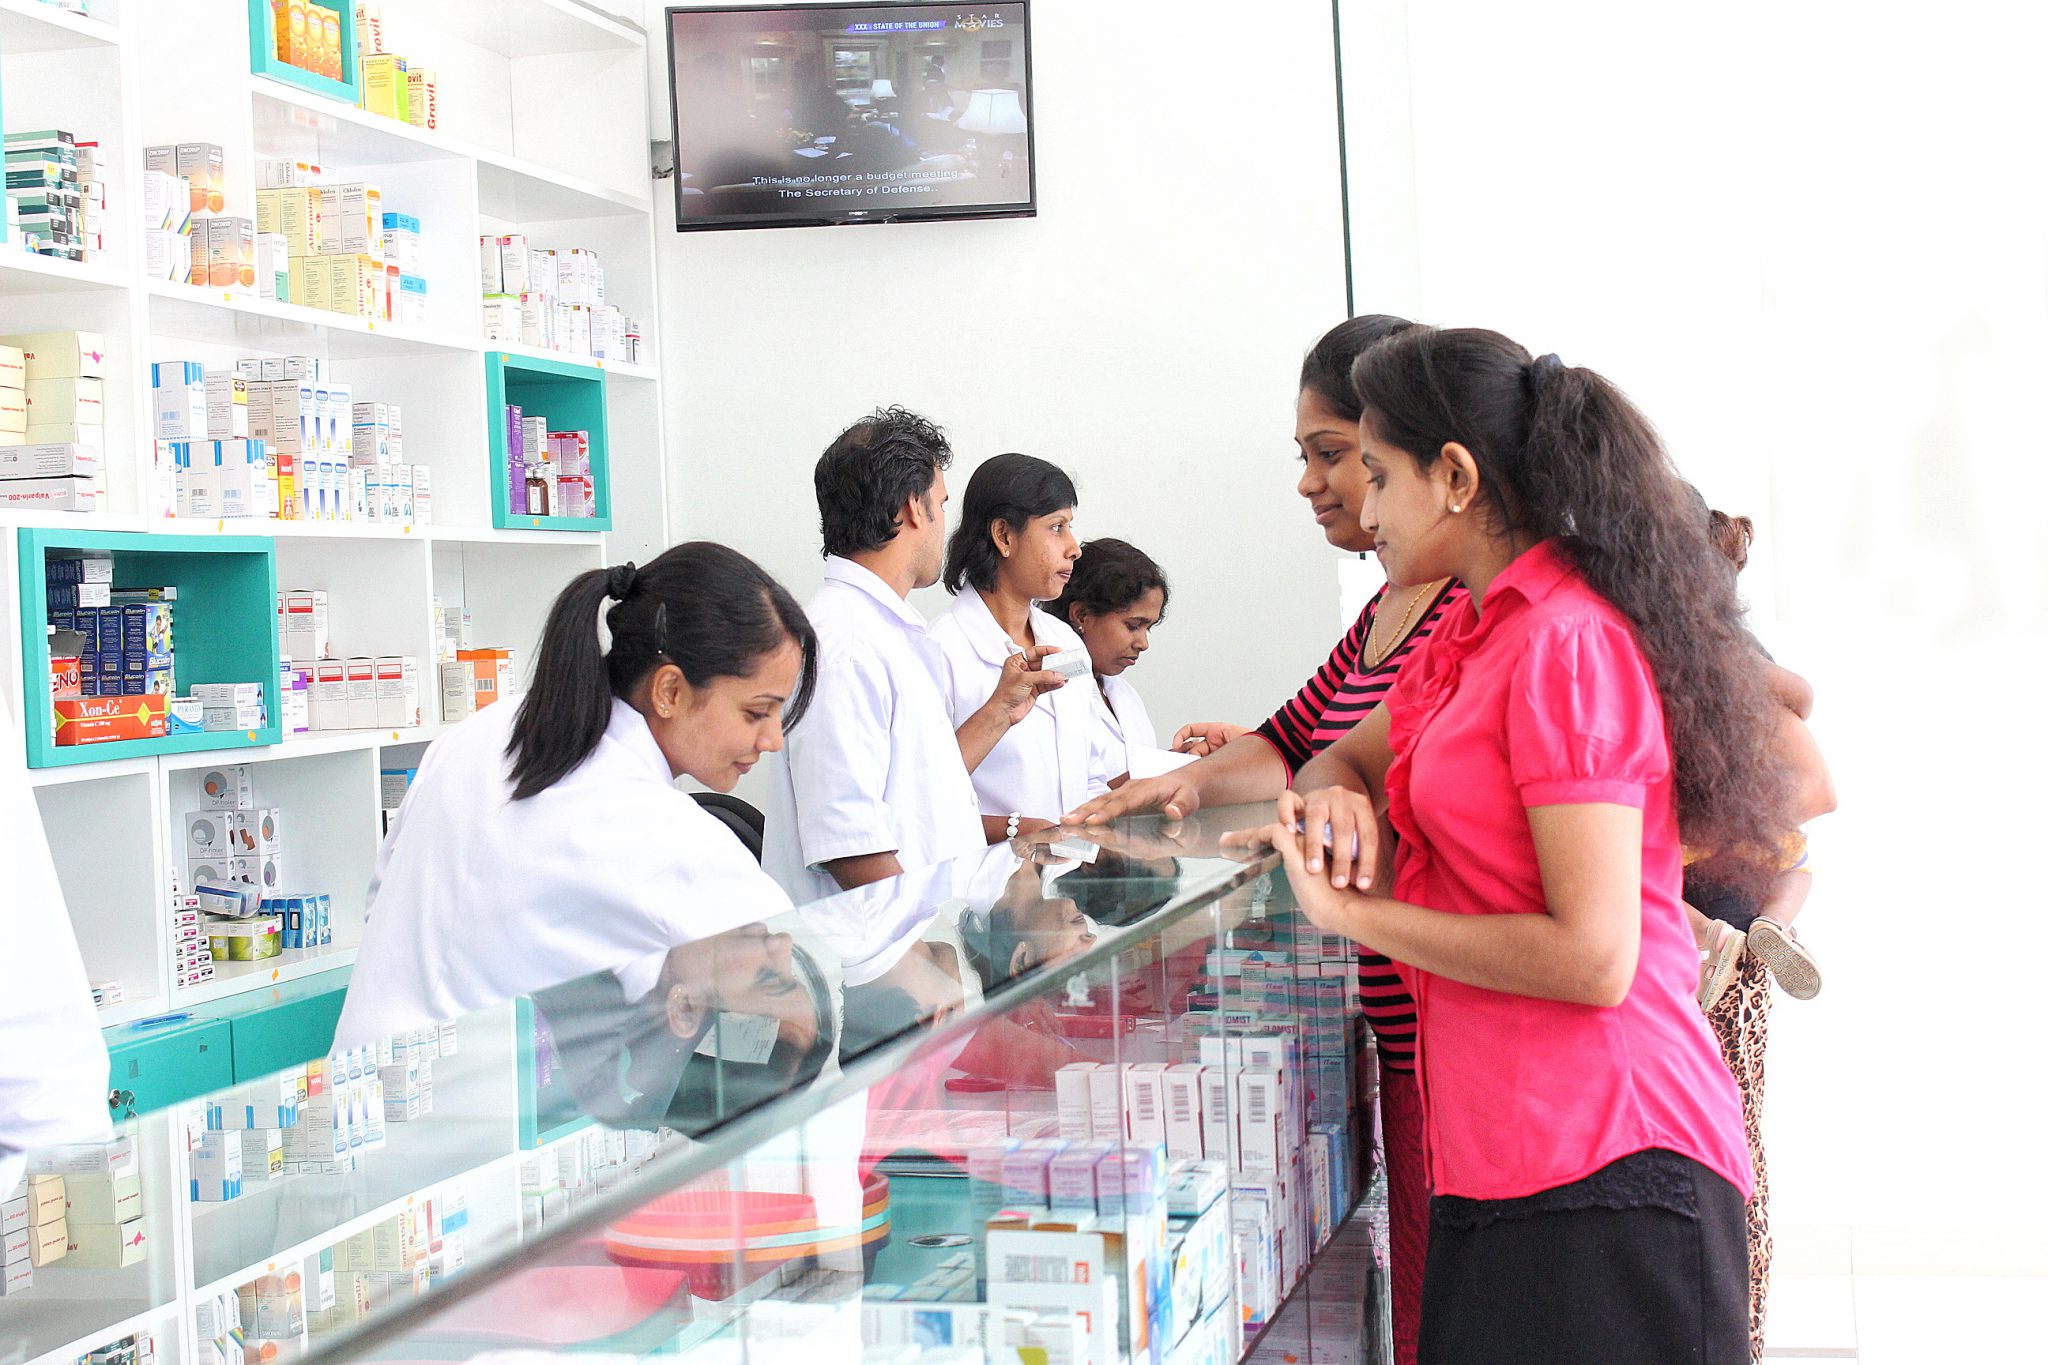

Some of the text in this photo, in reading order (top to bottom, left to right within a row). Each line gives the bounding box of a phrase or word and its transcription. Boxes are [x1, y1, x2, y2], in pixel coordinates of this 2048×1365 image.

[370, 17, 383, 53] rovit
[407, 73, 423, 83] ovit
[427, 83, 436, 130] Grovit
[753, 176, 778, 185] This
[781, 176, 792, 184] is
[794, 176, 811, 184] no
[814, 174, 853, 185] longer
[866, 171, 908, 182] budget
[911, 169, 958, 180] meeting
[778, 189, 802, 198] The
[805, 187, 863, 198] Secretary
[866, 186, 879, 195] of
[8, 491, 50, 501] Valparin-200
